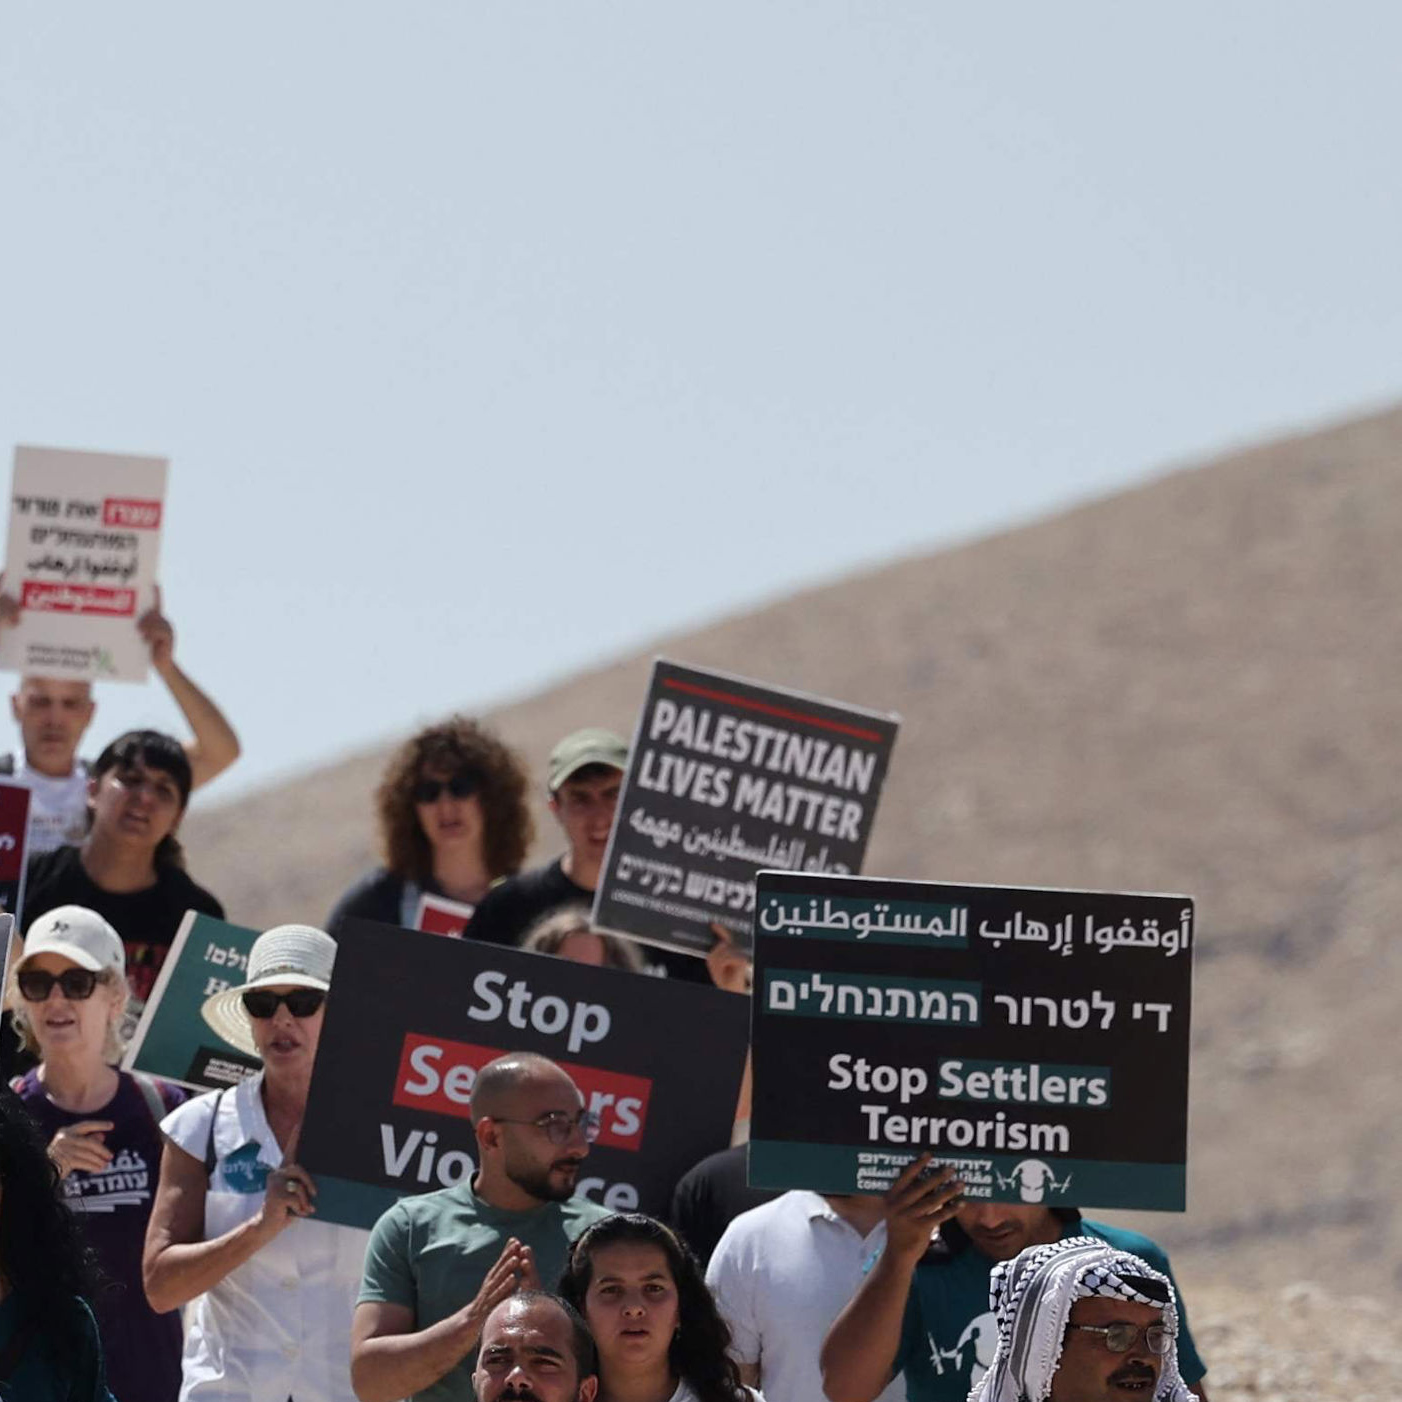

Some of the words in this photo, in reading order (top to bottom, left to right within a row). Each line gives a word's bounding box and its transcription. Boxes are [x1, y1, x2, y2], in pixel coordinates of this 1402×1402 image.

[650, 700, 877, 794] PALESTINIAN
[637, 751, 733, 807] LIVES
[733, 774, 863, 842] MATTER
[759, 898, 968, 940] المستوطنين
[979, 912, 1073, 957] إرهاب
[1084, 908, 1191, 956] أوقفوا
[467, 970, 610, 1053] Stop
[769, 974, 978, 1023] המתנחלים
[994, 991, 1115, 1030] לטרור
[1132, 1003, 1173, 1033] די
[404, 1044, 641, 1136] Sers
[828, 1054, 927, 1102] Stop
[938, 1060, 1107, 1106] Settlers
[860, 1105, 1069, 1152] Terrorism
[380, 1123, 638, 1211] Vioce
